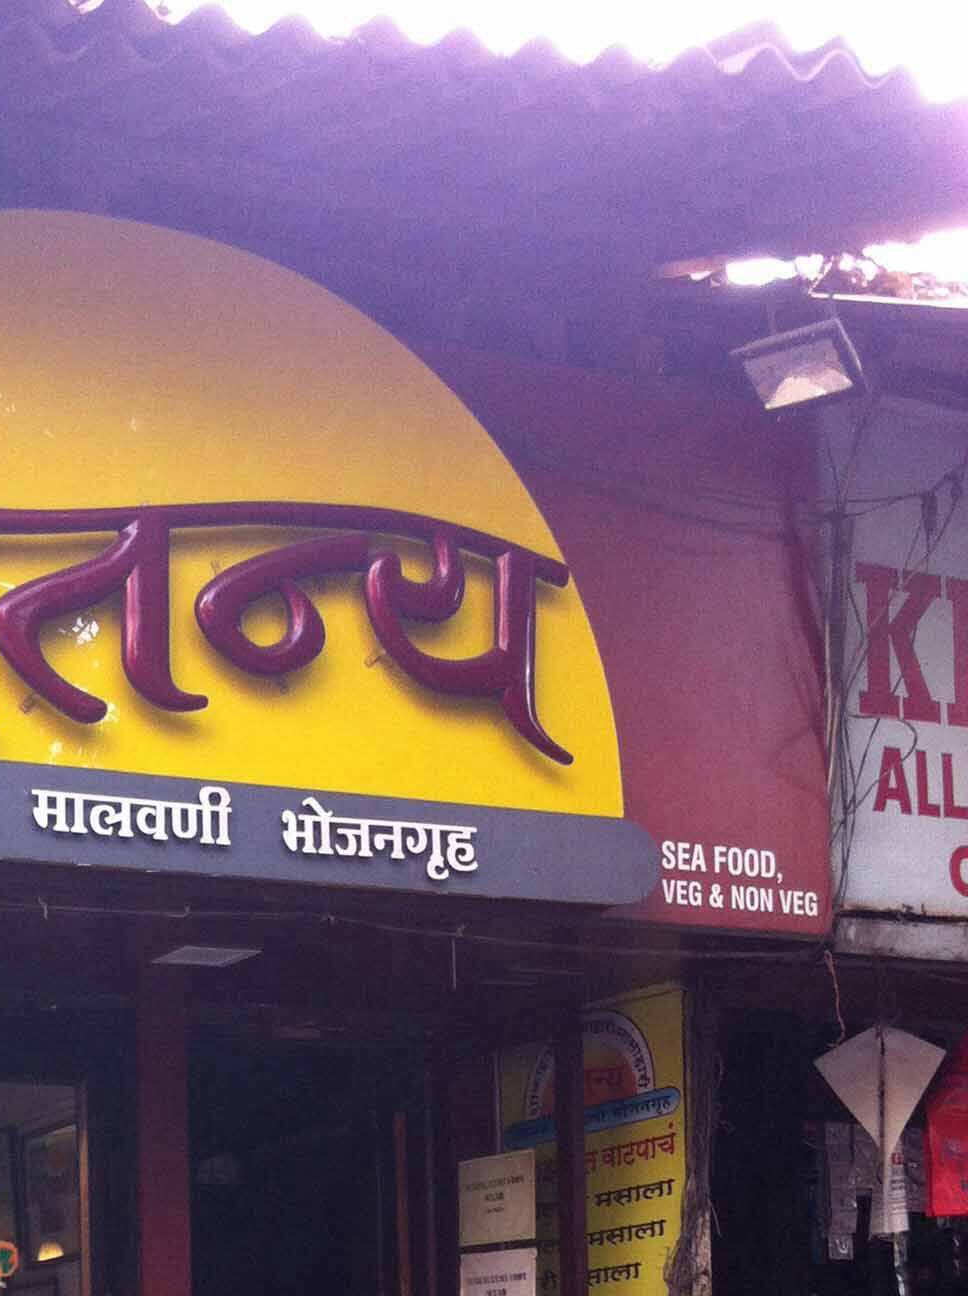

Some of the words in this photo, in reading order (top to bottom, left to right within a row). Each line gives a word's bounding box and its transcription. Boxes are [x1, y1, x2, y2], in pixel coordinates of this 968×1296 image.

[32, 786, 232, 846] मालवणी
[281, 797, 479, 880] भोजनगृह
[661, 840, 707, 873] SEA
[715, 846, 784, 883] FOOD,
[662, 879, 702, 908] VEG
[709, 884, 724, 908] &
[731, 885, 774, 913] NON
[780, 891, 819, 917] VEG
[594, 1179, 675, 1206] मसाला
[585, 1219, 667, 1246] मसाला
[587, 1261, 642, 1286] साला
